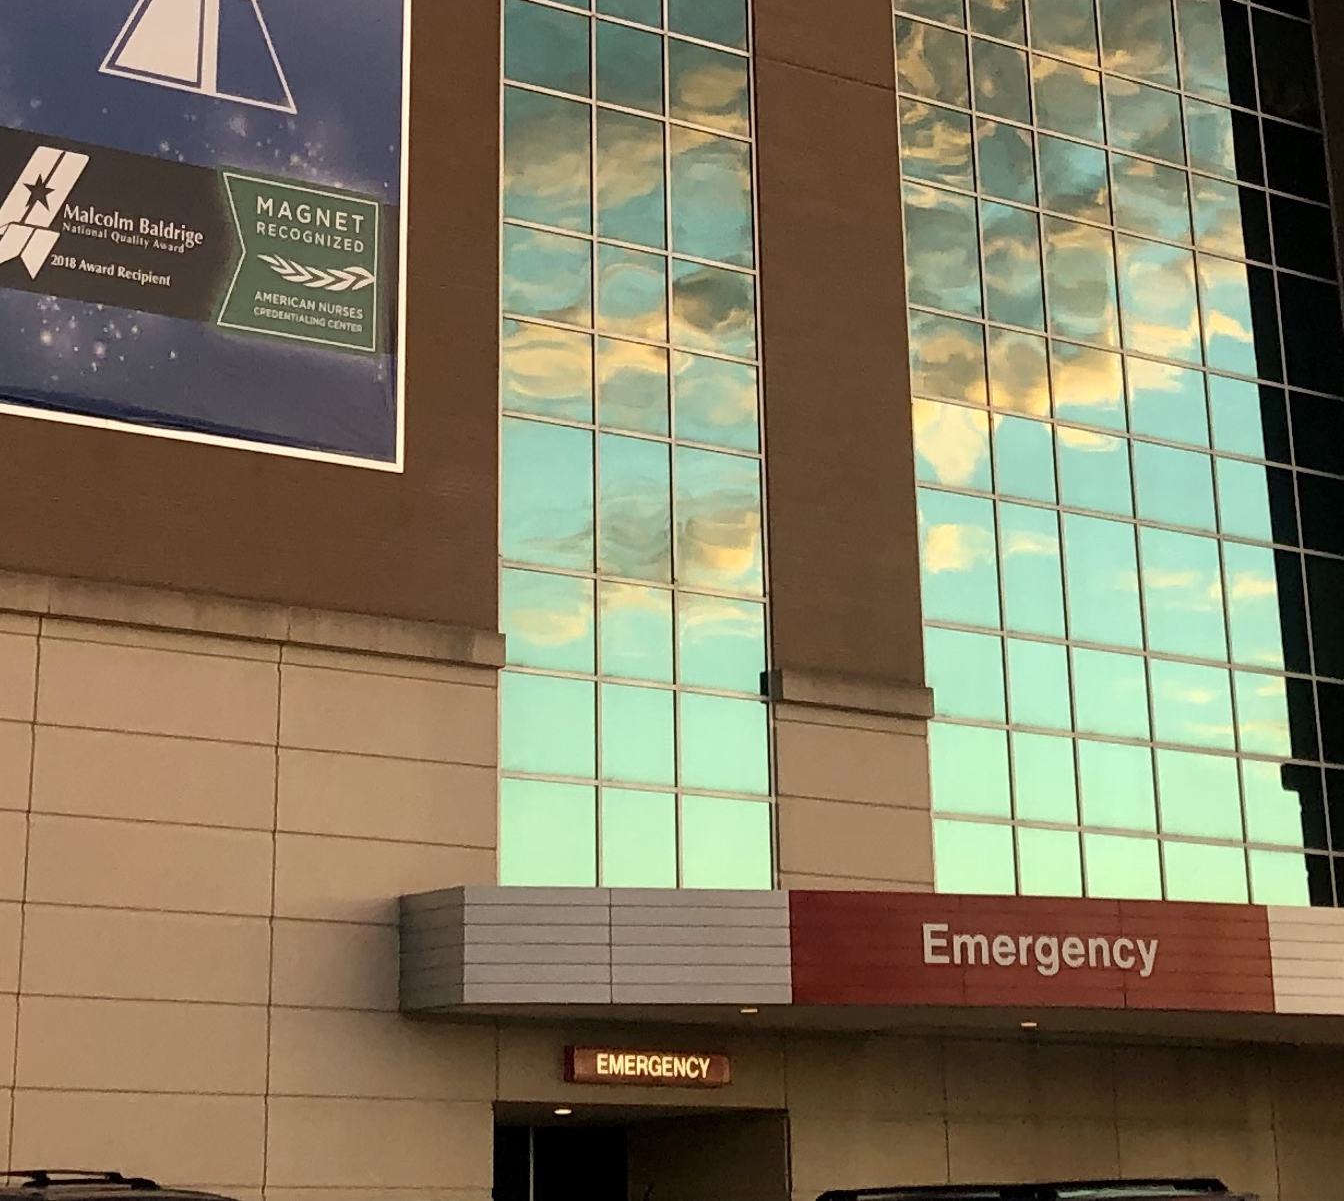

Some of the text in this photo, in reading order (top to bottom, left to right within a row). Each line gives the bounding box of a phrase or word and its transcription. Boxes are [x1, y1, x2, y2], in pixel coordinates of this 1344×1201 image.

[63, 203, 204, 249] Malcolm Baldrige
[256, 195, 364, 234] MAGNET
[62, 222, 185, 254] National Quality Award
[256, 221, 364, 253] RECOGNIZED
[51, 254, 172, 287] 2018 Award Recipient
[253, 306, 363, 333] CREDENTIALING CENTER
[254, 290, 364, 320] AMERICAN NURSES
[922, 922, 1159, 978] Emergency
[596, 1052, 711, 1079] EMERGENCY
